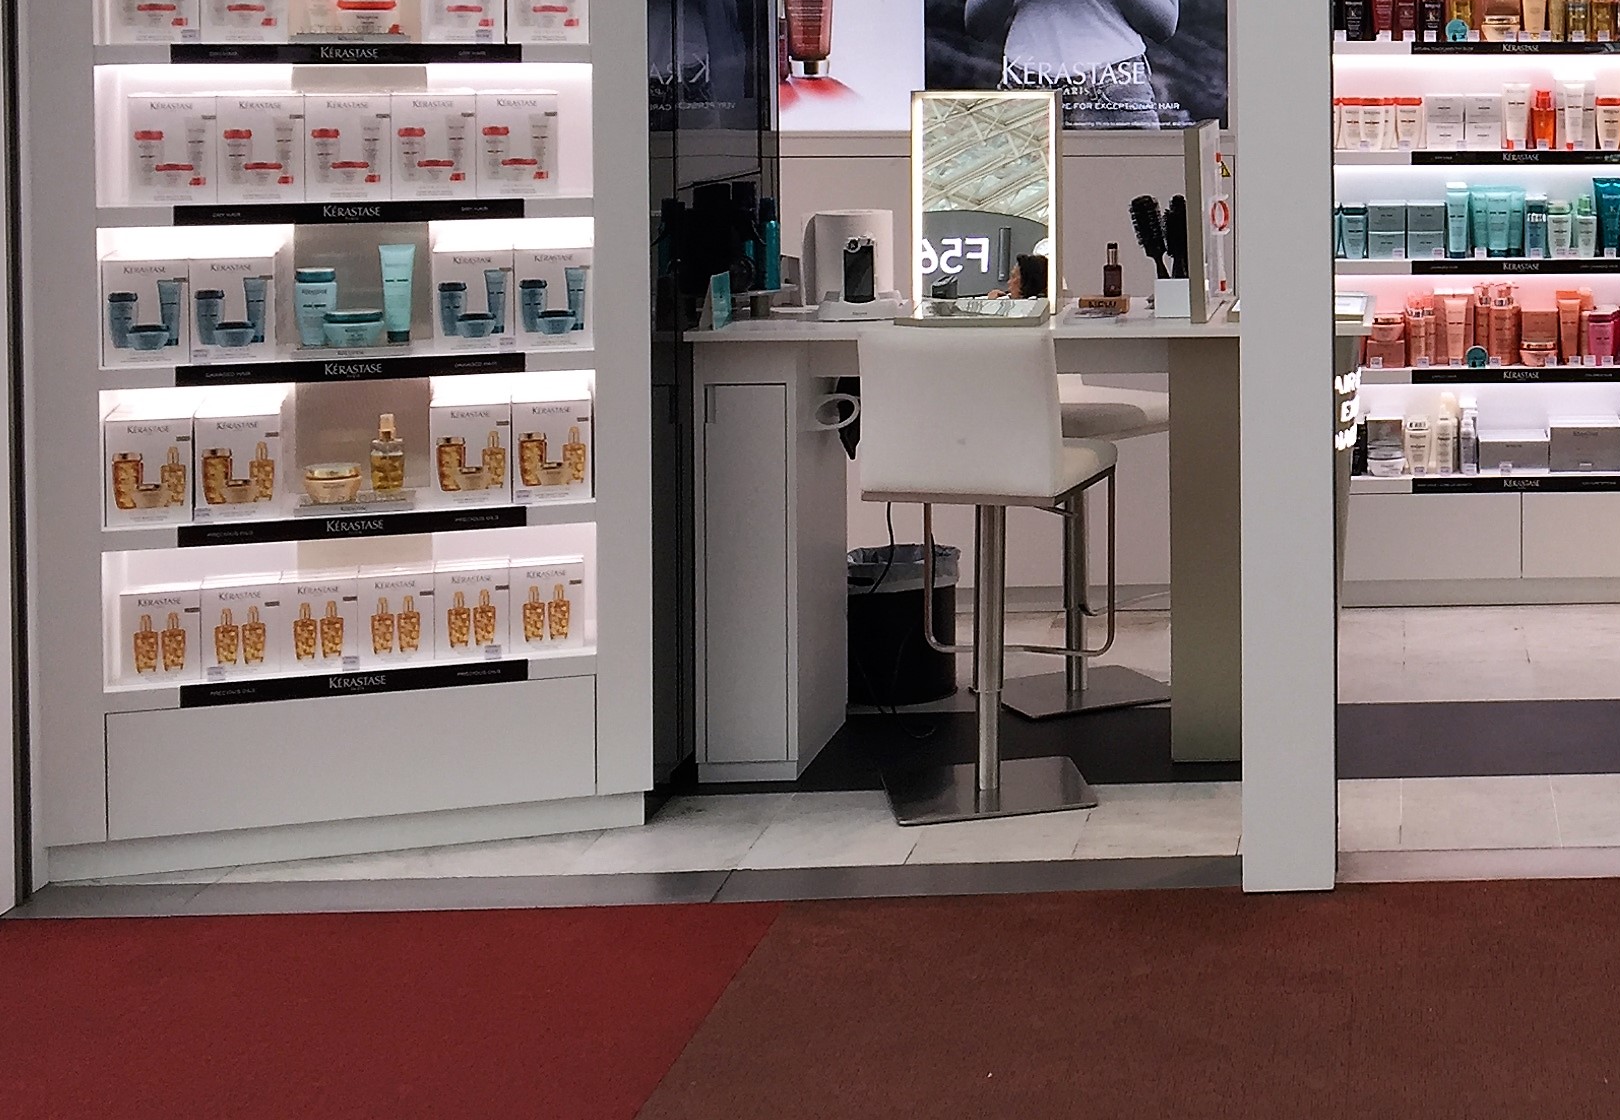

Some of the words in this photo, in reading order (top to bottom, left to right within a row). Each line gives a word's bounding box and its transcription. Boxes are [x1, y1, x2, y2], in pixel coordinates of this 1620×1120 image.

[320, 46, 379, 59] KÉRASTASE
[1002, 55, 1146, 86] KÉRASTASE
[1158, 102, 1180, 110] HAIR
[323, 205, 380, 217] KÉRASTASE
[324, 363, 382, 375] KÉRASTASE
[326, 520, 383, 533] KÉRASTASE
[329, 675, 387, 689] KÉRASTASE
